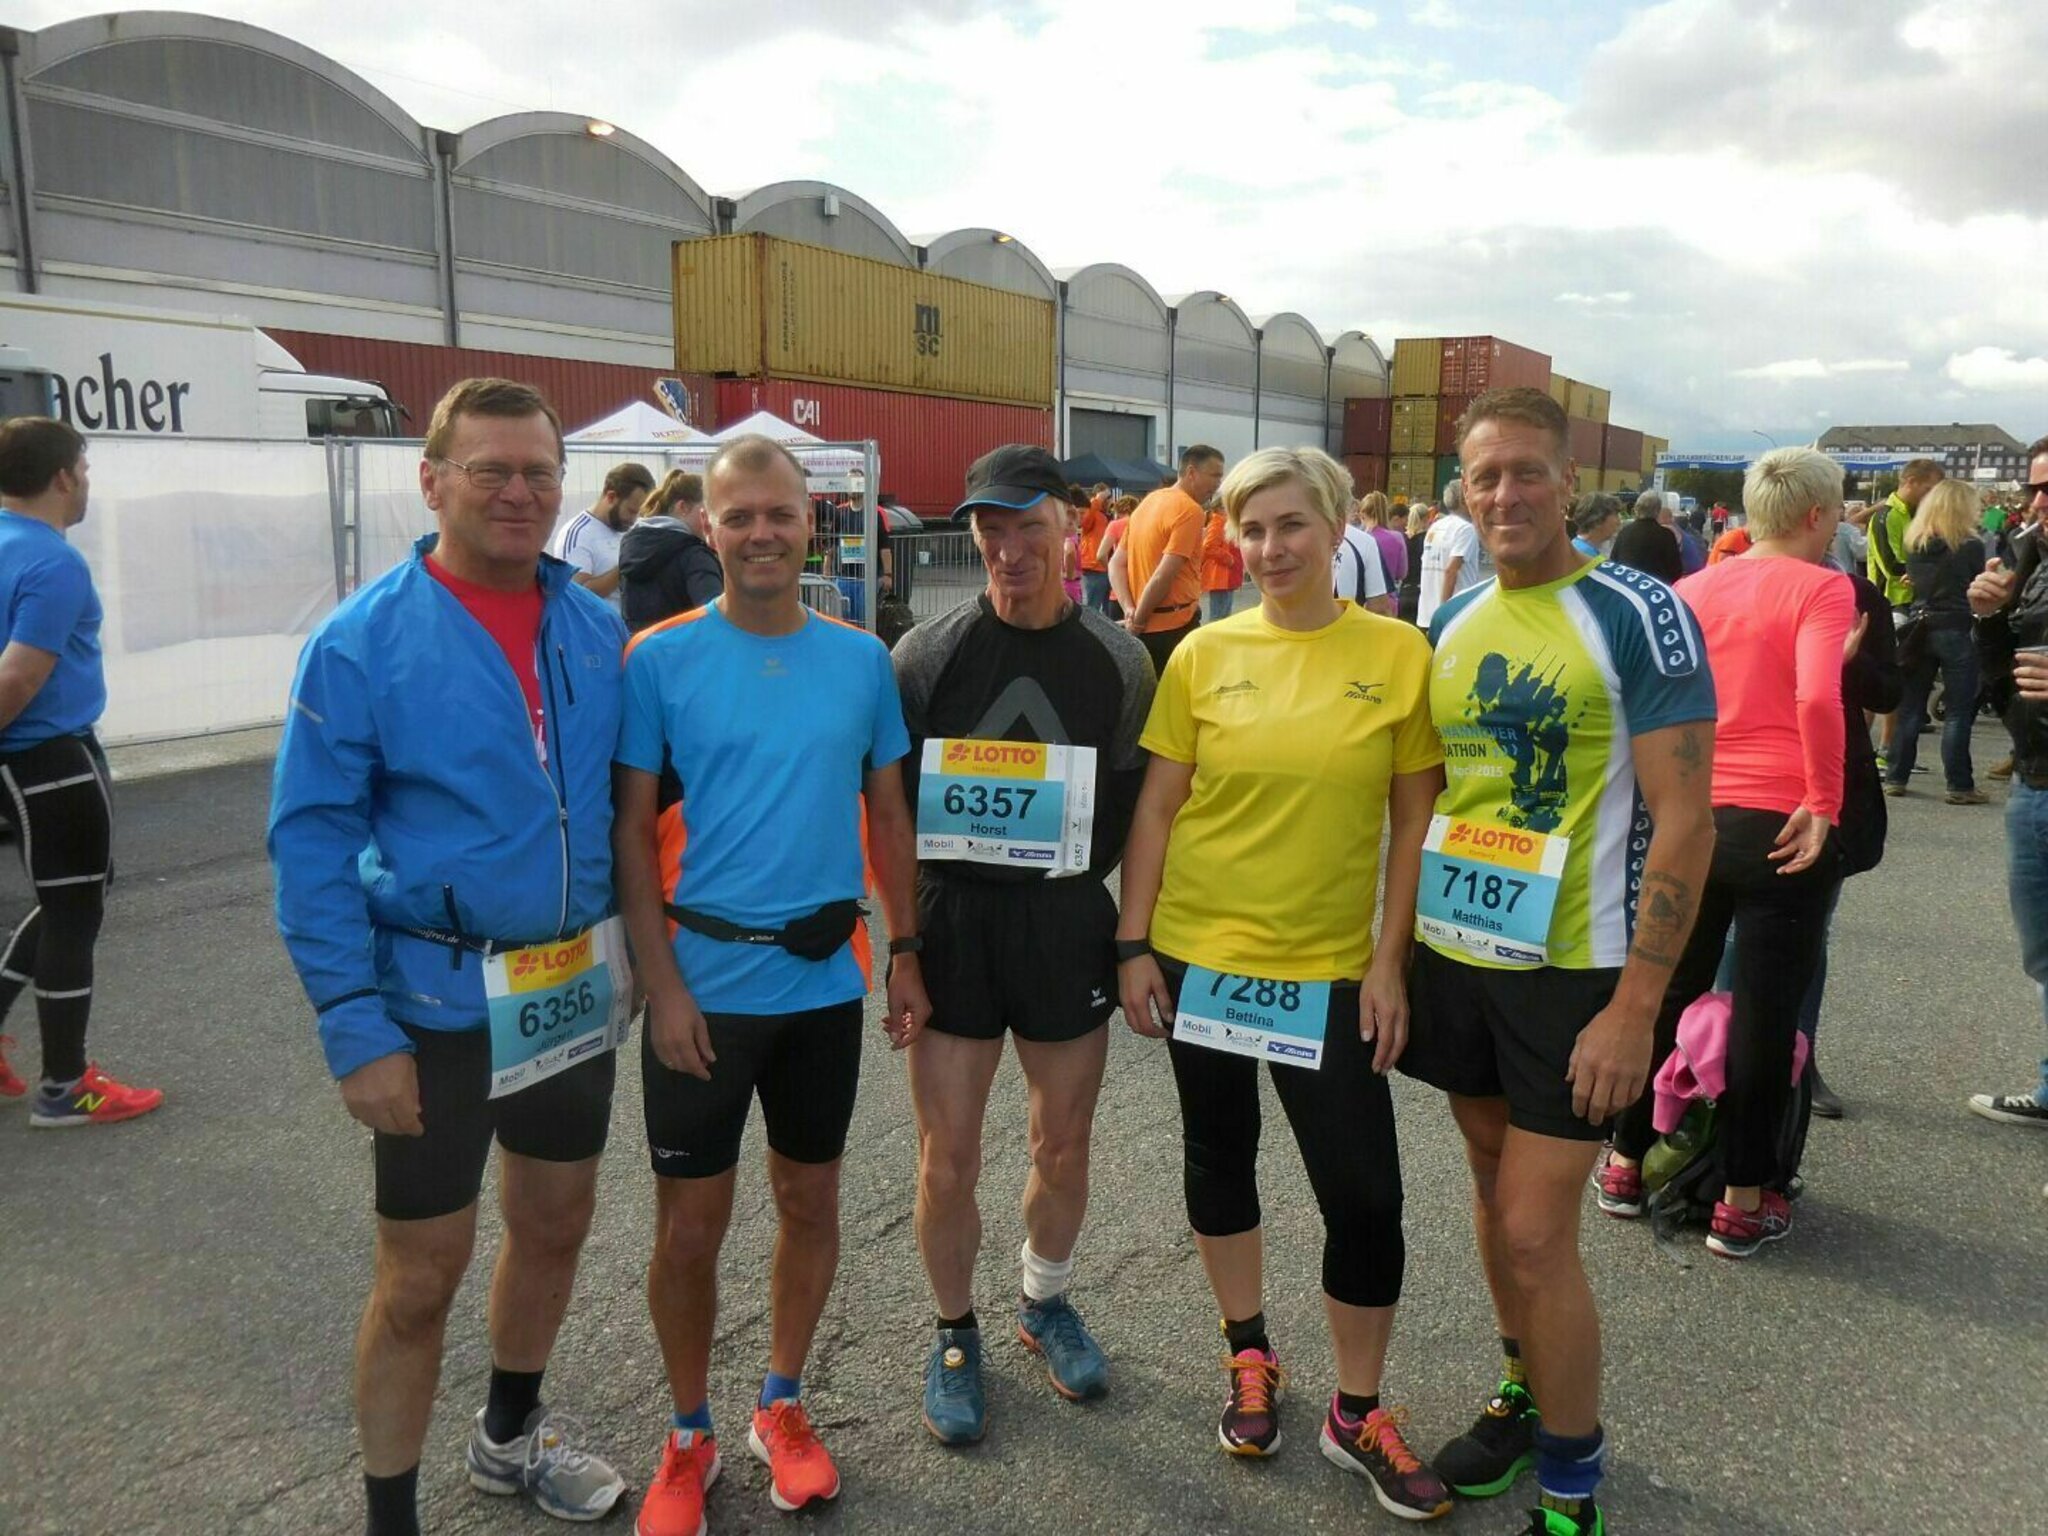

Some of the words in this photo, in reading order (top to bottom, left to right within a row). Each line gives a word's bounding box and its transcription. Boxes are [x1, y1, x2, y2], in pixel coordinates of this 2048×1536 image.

[793, 398, 820, 426] CAI
[974, 745, 1037, 765] LOTTO
[1444, 743, 1487, 758] ATHON
[943, 783, 1038, 820] 6357
[970, 822, 1007, 836] Horst
[1472, 827, 1534, 856] LOTTO
[923, 839, 954, 849] Mobil
[1442, 864, 1528, 914] 7187
[1451, 908, 1503, 932] Matthias
[544, 937, 588, 970] LOTTO
[1209, 973, 1301, 1012] 7288
[519, 980, 596, 1038] 6356
[1225, 1007, 1275, 1028] Bettina
[1181, 1020, 1212, 1035] Mobil
